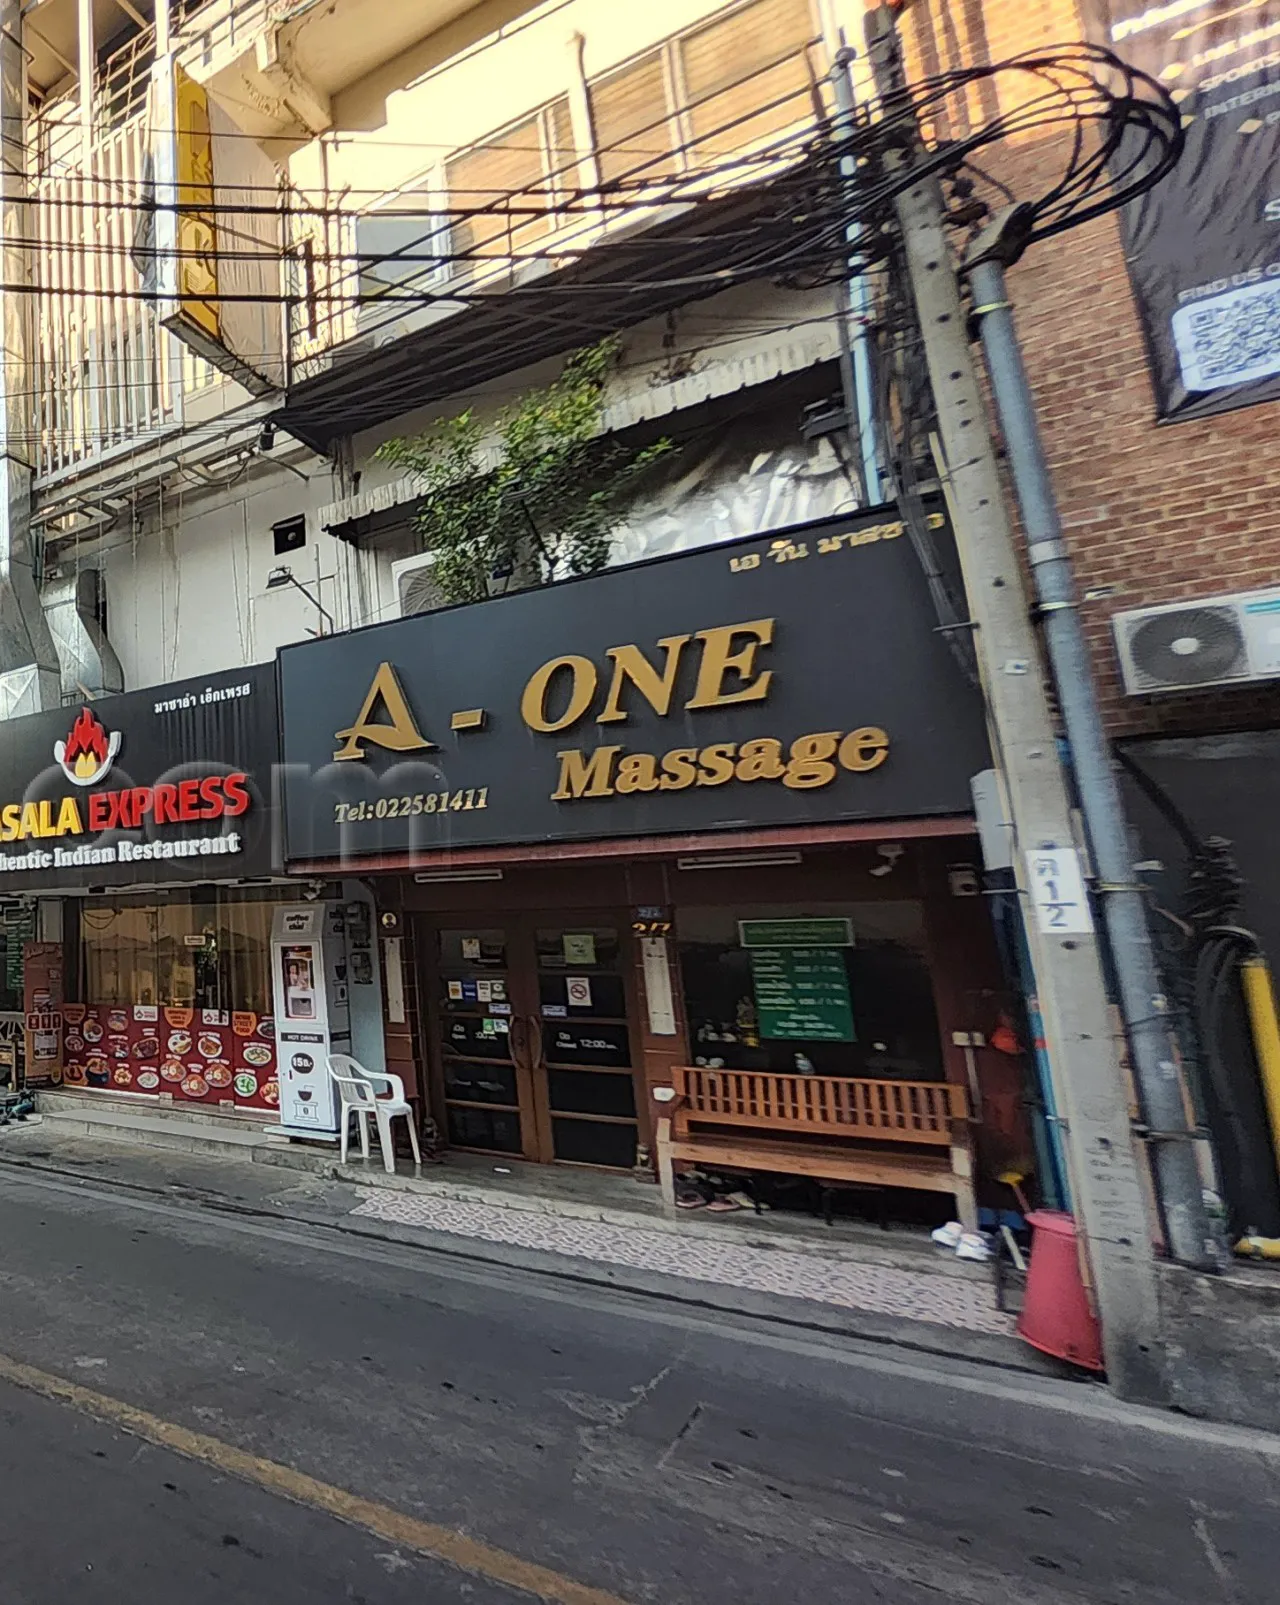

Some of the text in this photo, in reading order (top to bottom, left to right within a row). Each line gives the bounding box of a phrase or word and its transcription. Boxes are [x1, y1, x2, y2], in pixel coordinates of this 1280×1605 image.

[333, 660, 439, 761] A
[521, 617, 776, 733] ONE
[551, 725, 890, 800] Massage
[88, 772, 252, 832] EXPRESS
[53, 844, 117, 867] Indian
[117, 832, 242, 862] Restaurant
